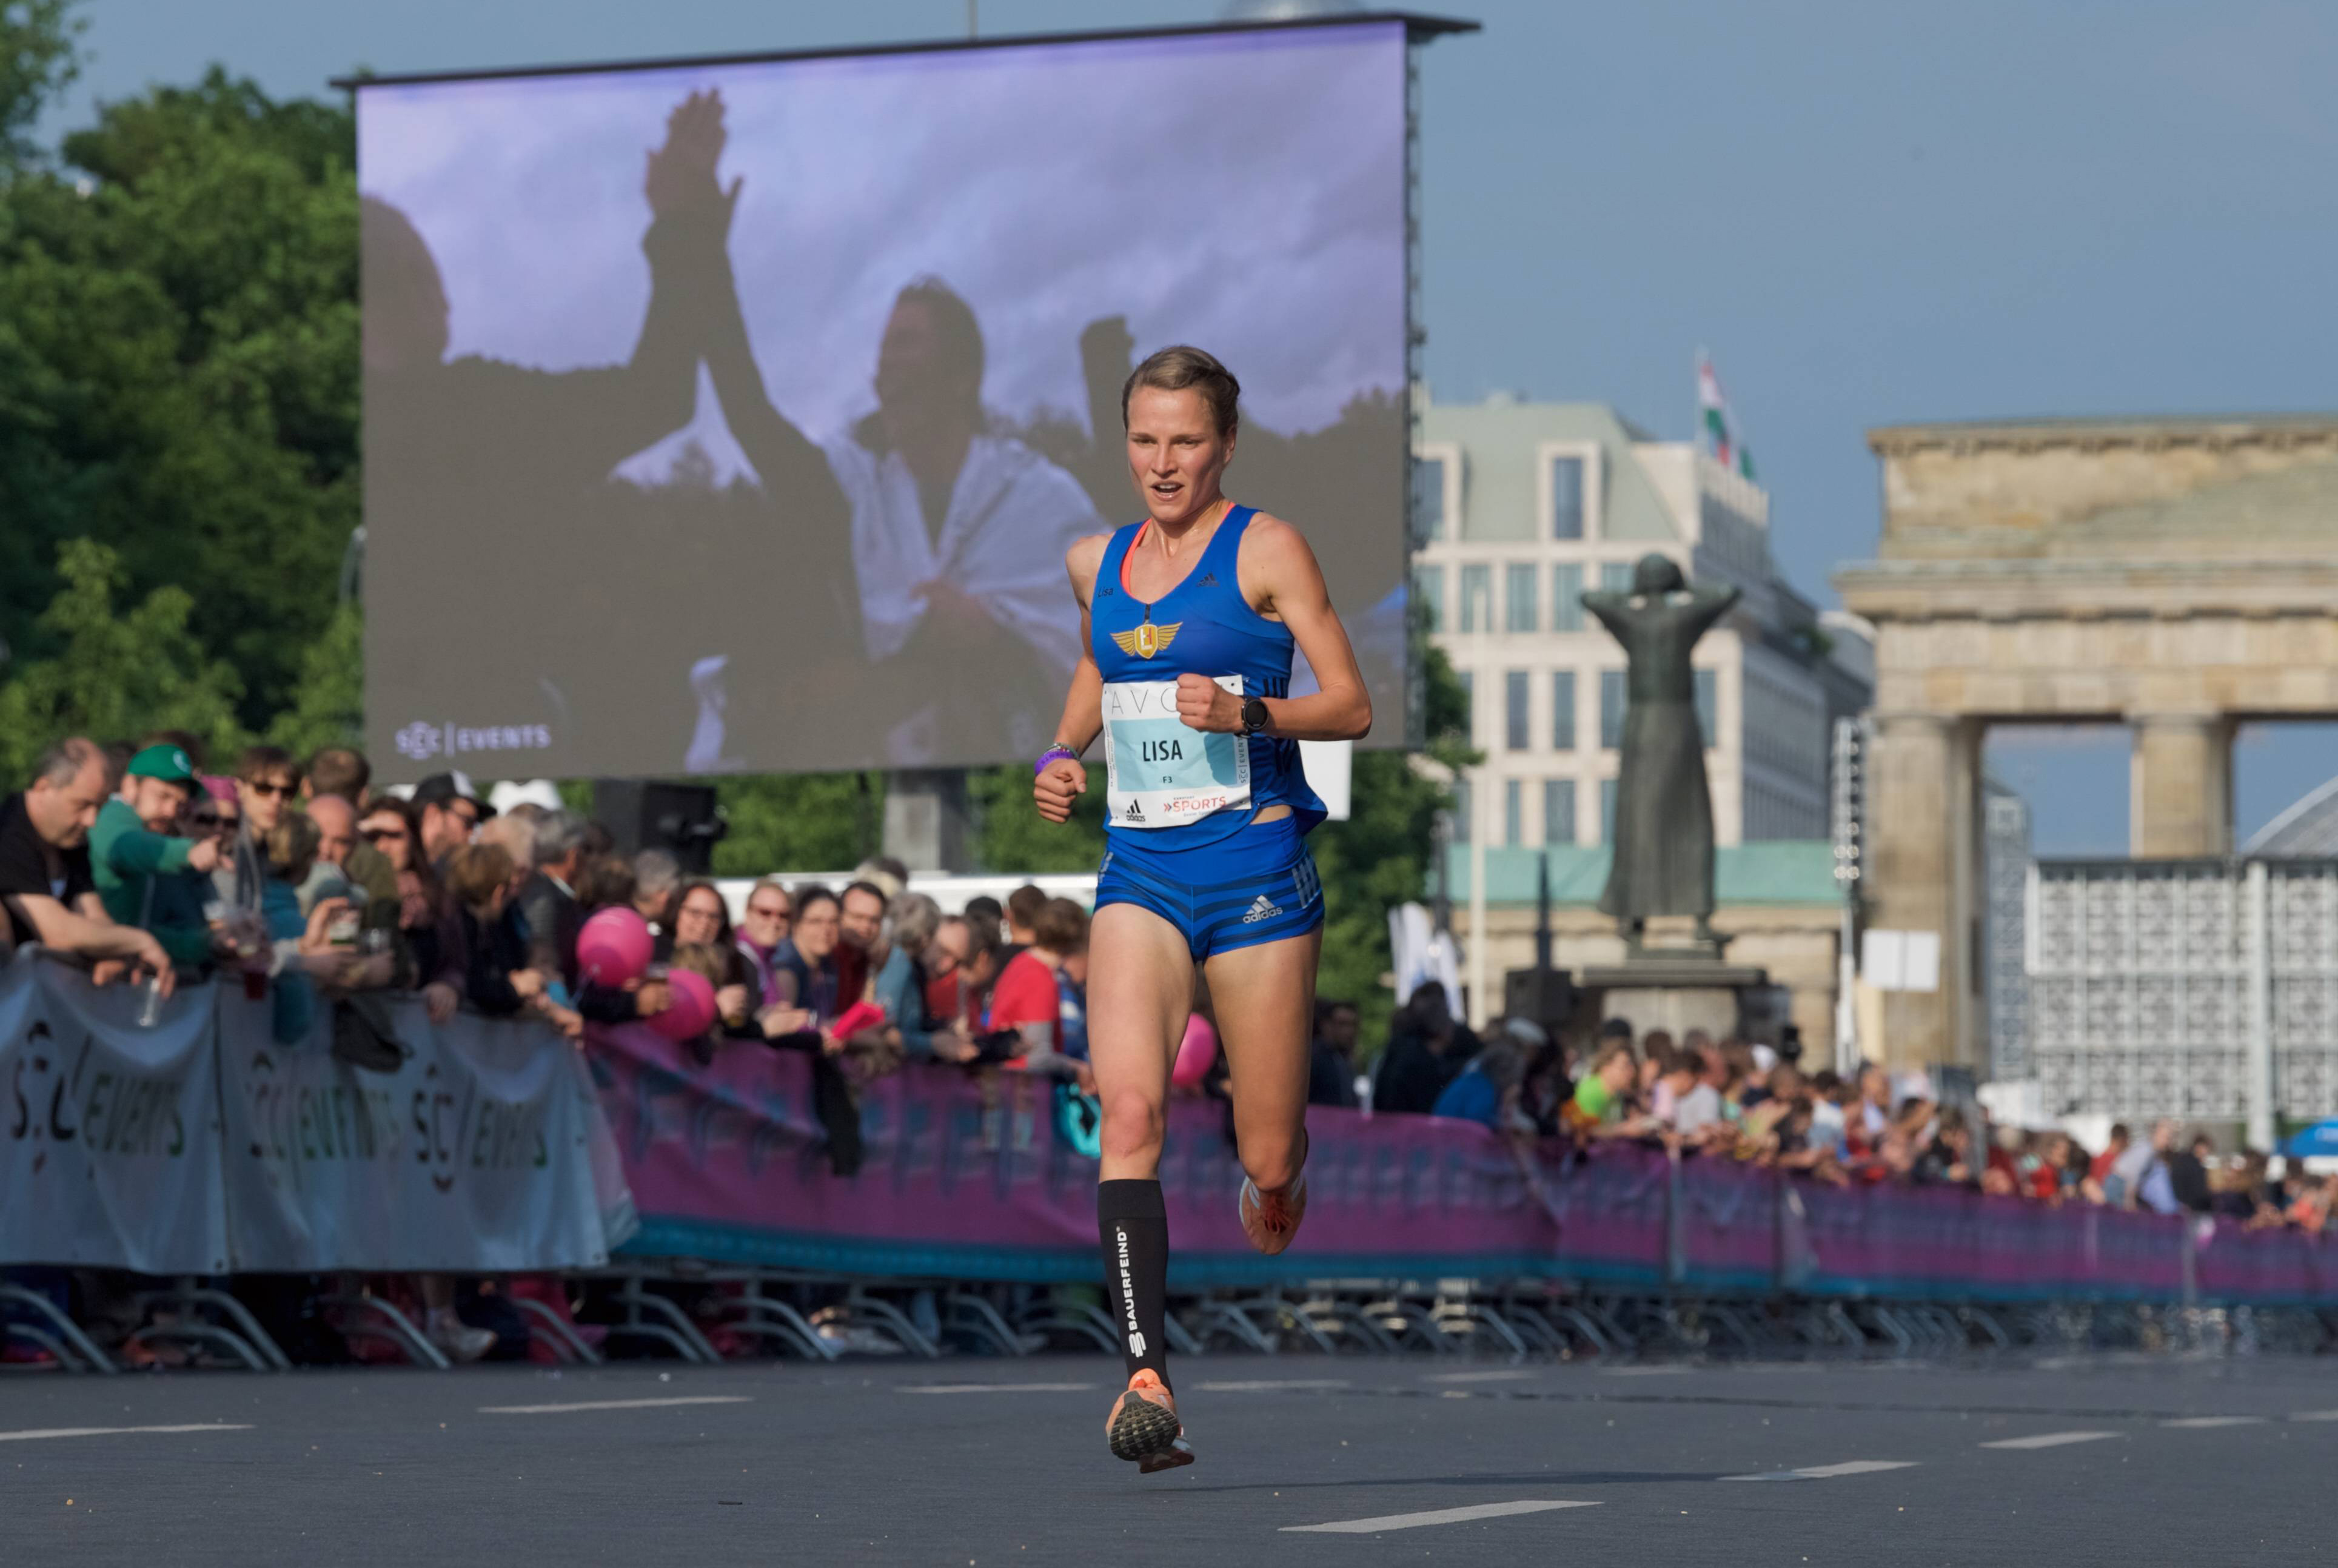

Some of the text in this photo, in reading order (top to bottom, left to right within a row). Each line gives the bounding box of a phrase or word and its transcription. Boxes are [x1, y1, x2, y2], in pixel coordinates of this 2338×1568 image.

[1097, 586, 1114, 598] Lisa
[1111, 686, 1179, 715] AVO
[457, 725, 551, 751] EVENTS
[1142, 739, 1183, 762] LISA
[1173, 796, 1227, 813] SPORTS
[1126, 814, 1145, 822] adidas
[1242, 906, 1284, 924] adidas
[1117, 1231, 1138, 1332] BAUERFEIND
